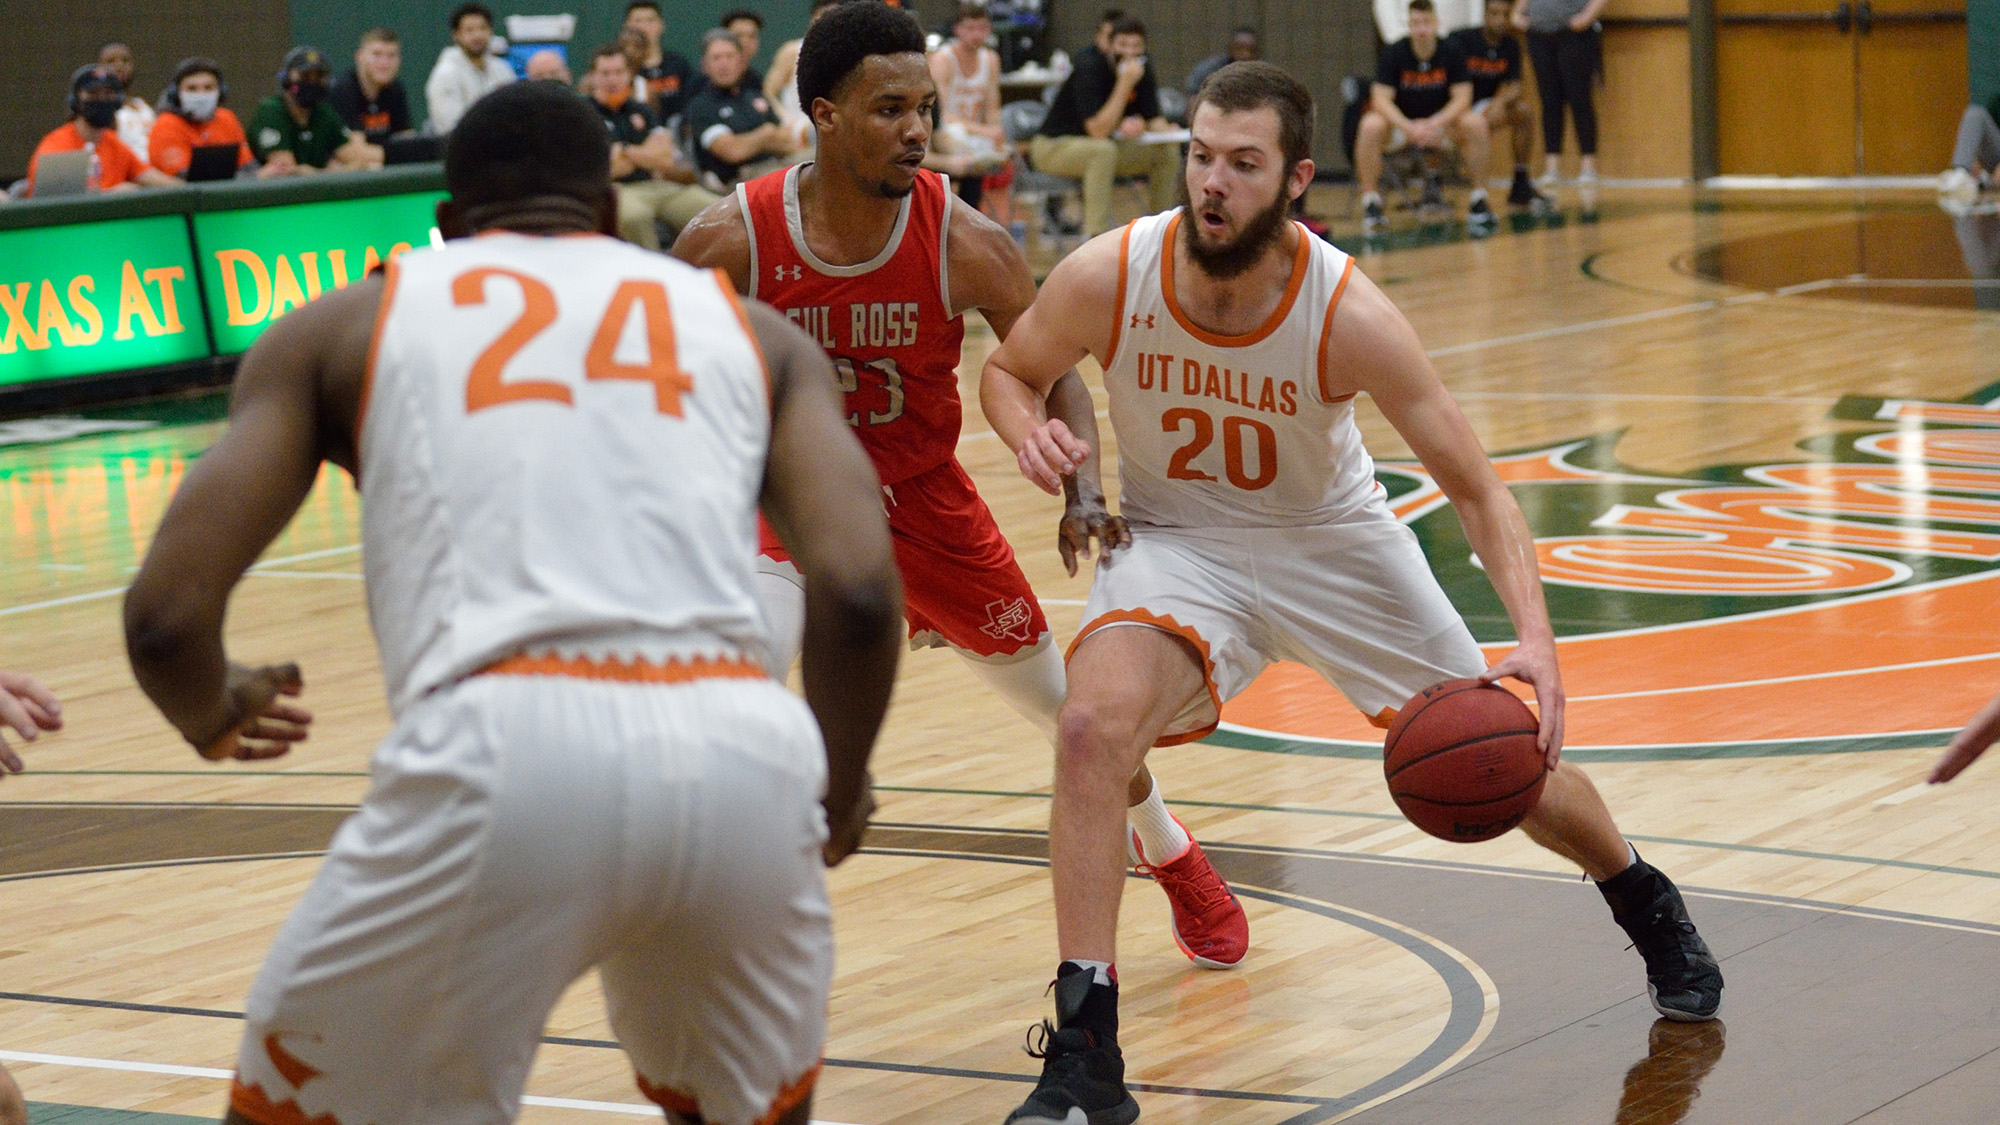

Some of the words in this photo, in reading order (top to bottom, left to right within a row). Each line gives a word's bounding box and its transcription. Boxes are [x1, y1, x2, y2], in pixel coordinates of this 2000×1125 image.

[112, 259, 186, 341] AT
[214, 241, 413, 326] DALL
[850, 302, 919, 348] ROSS
[451, 266, 694, 421] 24
[1138, 352, 1174, 393] UT
[1183, 358, 1298, 417] DALLAS
[1161, 407, 1278, 491] 20
